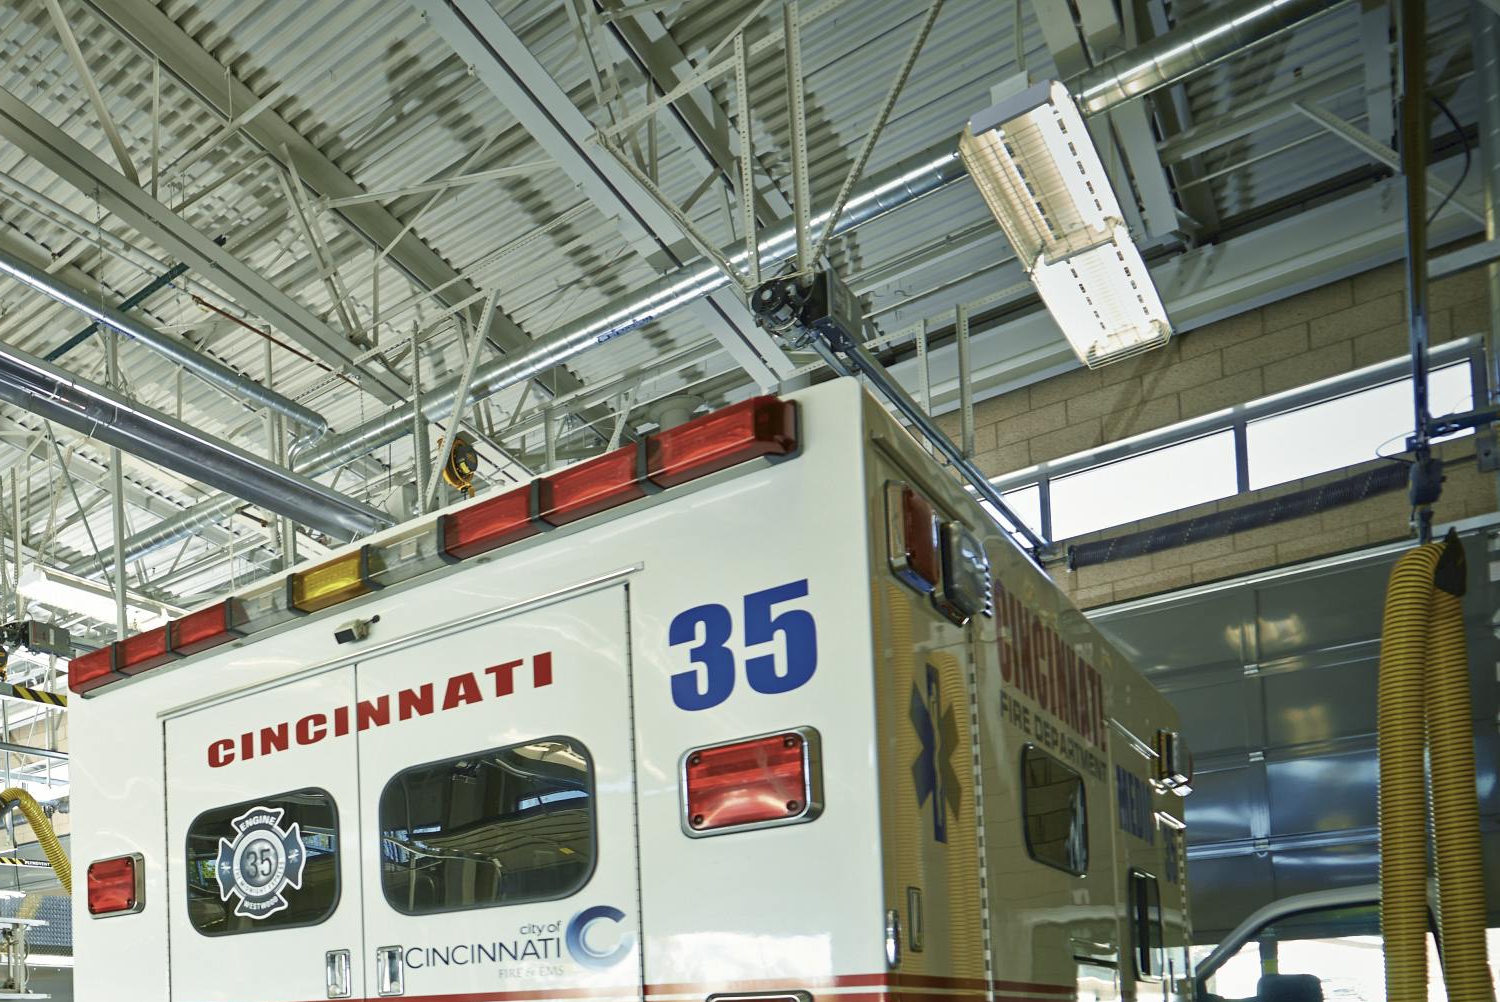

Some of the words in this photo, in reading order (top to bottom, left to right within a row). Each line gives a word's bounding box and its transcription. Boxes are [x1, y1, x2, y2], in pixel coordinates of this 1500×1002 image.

[668, 578, 817, 712] 35
[994, 578, 1107, 753] CINCINNATI
[207, 650, 554, 769] CINCINNATI
[1000, 689, 1031, 736] FIRE
[1034, 713, 1108, 783] DEPARTMENT
[239, 815, 277, 831] ENGINE
[246, 848, 273, 879] 35
[243, 896, 279, 910] WESTWOOD
[519, 922, 546, 936] city
[546, 920, 562, 934] of
[405, 937, 562, 969] CINCINNATI
[500, 968, 522, 979] FIRE
[539, 965, 564, 977] EMS
